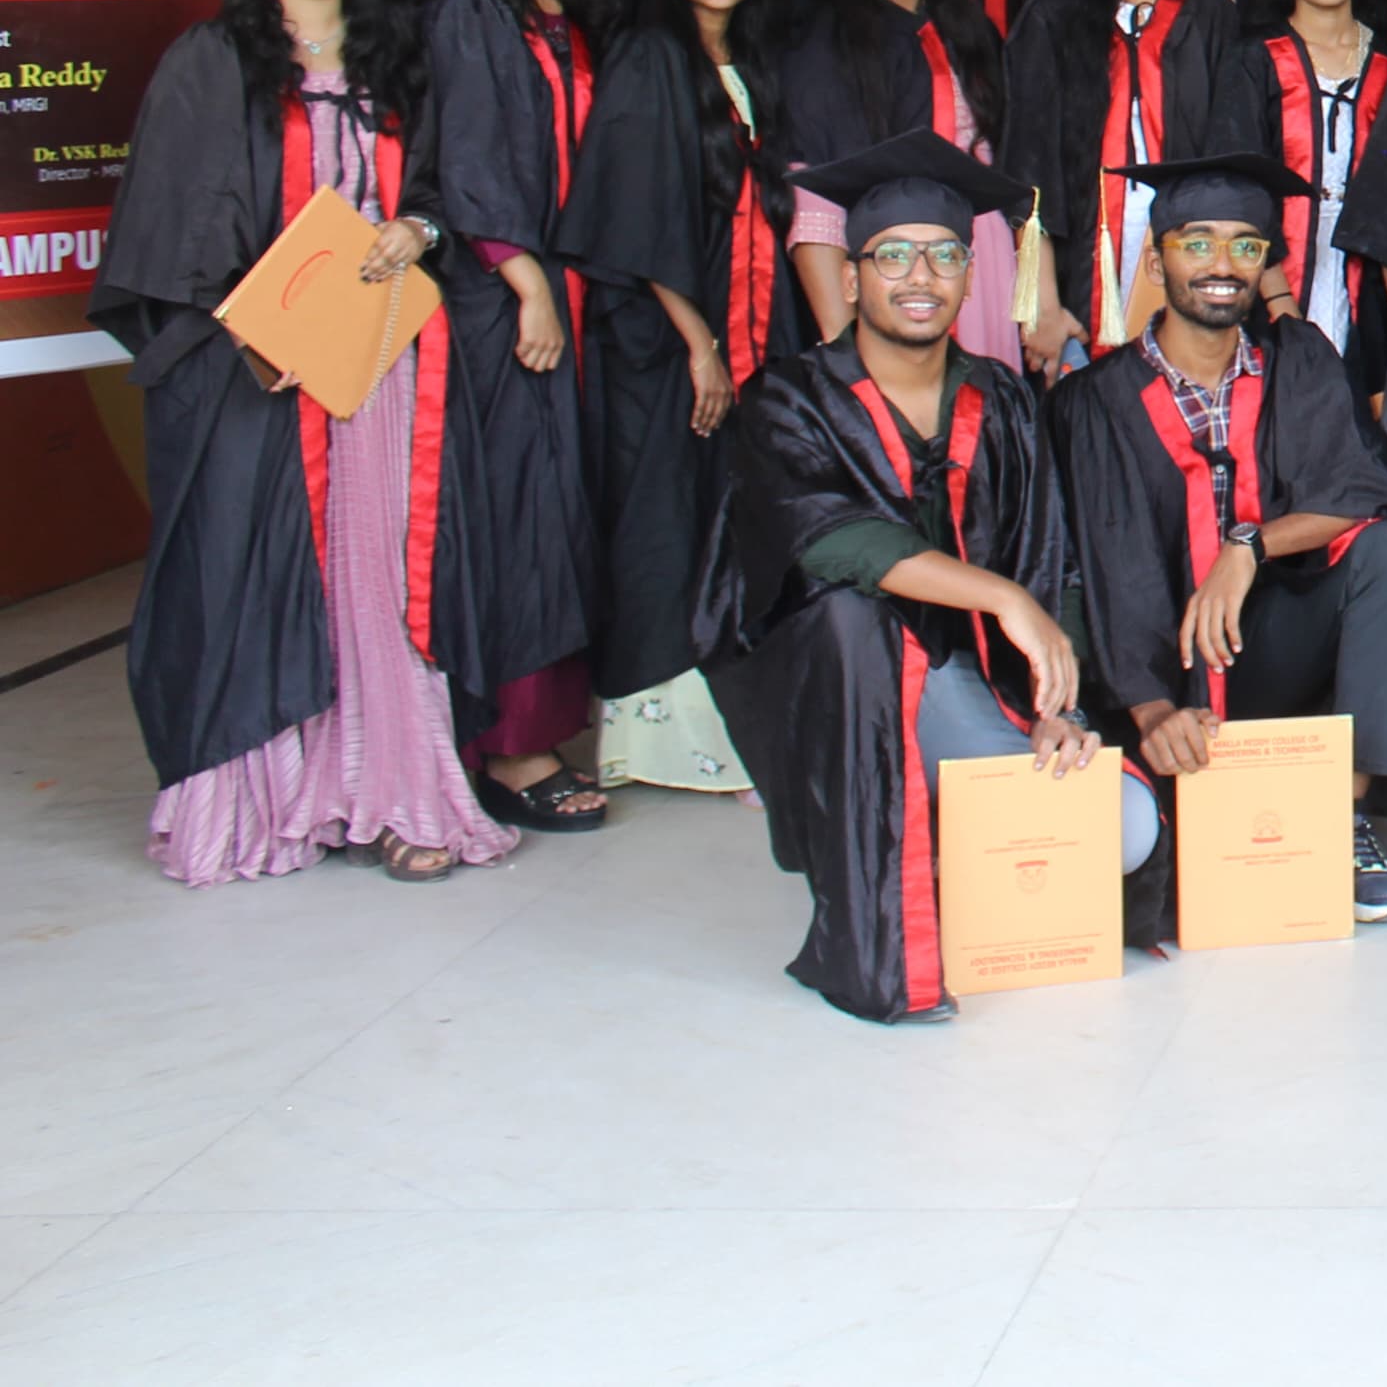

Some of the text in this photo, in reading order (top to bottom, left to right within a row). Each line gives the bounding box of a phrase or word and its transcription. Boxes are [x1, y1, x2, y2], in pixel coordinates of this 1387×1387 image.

[19, 62, 107, 92] Reddy
[12, 98, 48, 112] MRGI
[33, 146, 60, 162] Dr.
[62, 145, 97, 160] VSK
[39, 167, 91, 182] Director
